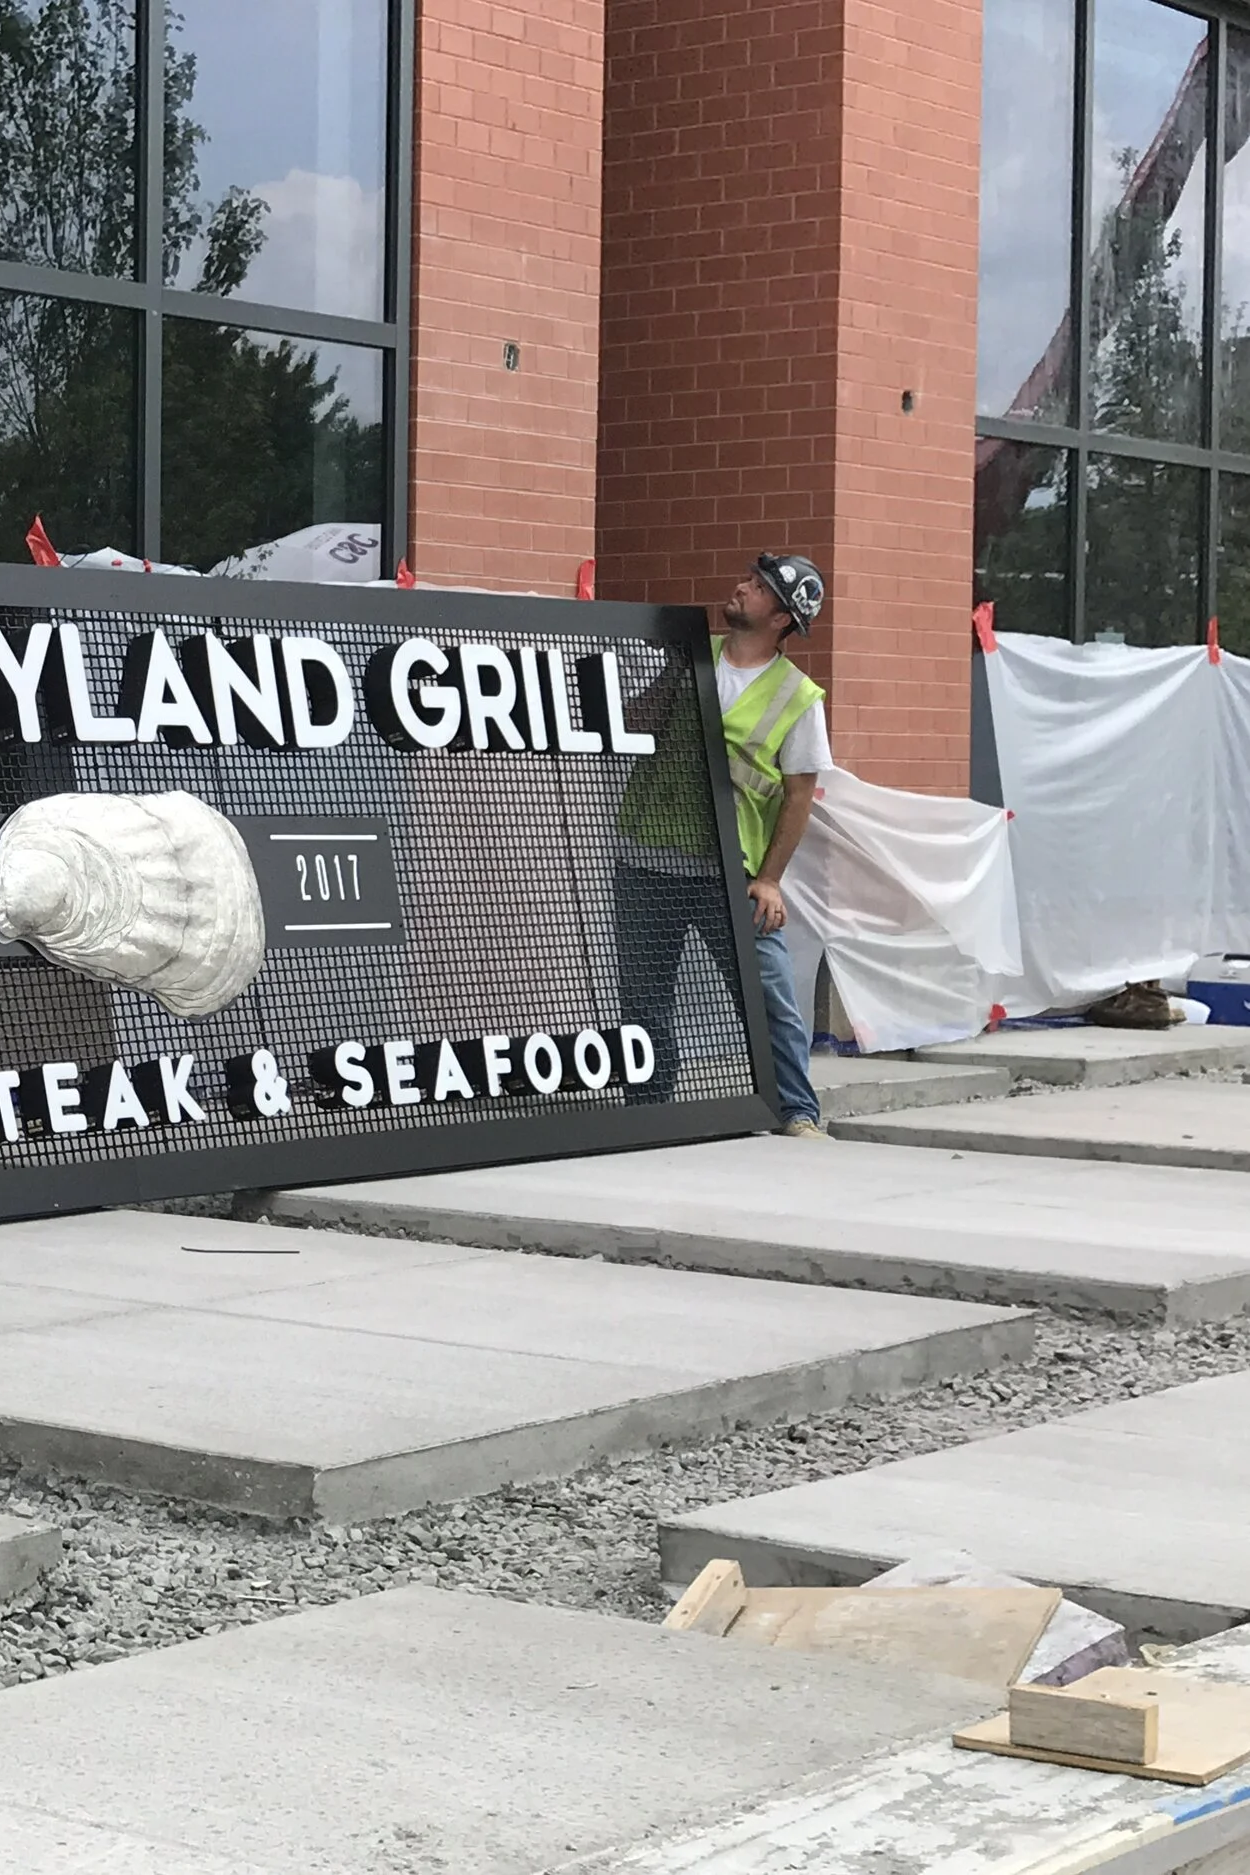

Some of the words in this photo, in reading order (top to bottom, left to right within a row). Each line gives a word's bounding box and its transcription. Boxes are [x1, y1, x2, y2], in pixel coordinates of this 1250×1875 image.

[390, 636, 656, 756] GRILL
[296, 854, 361, 901] 2017
[251, 1048, 292, 1117] &
[335, 1024, 655, 1107] SEAFOOD
